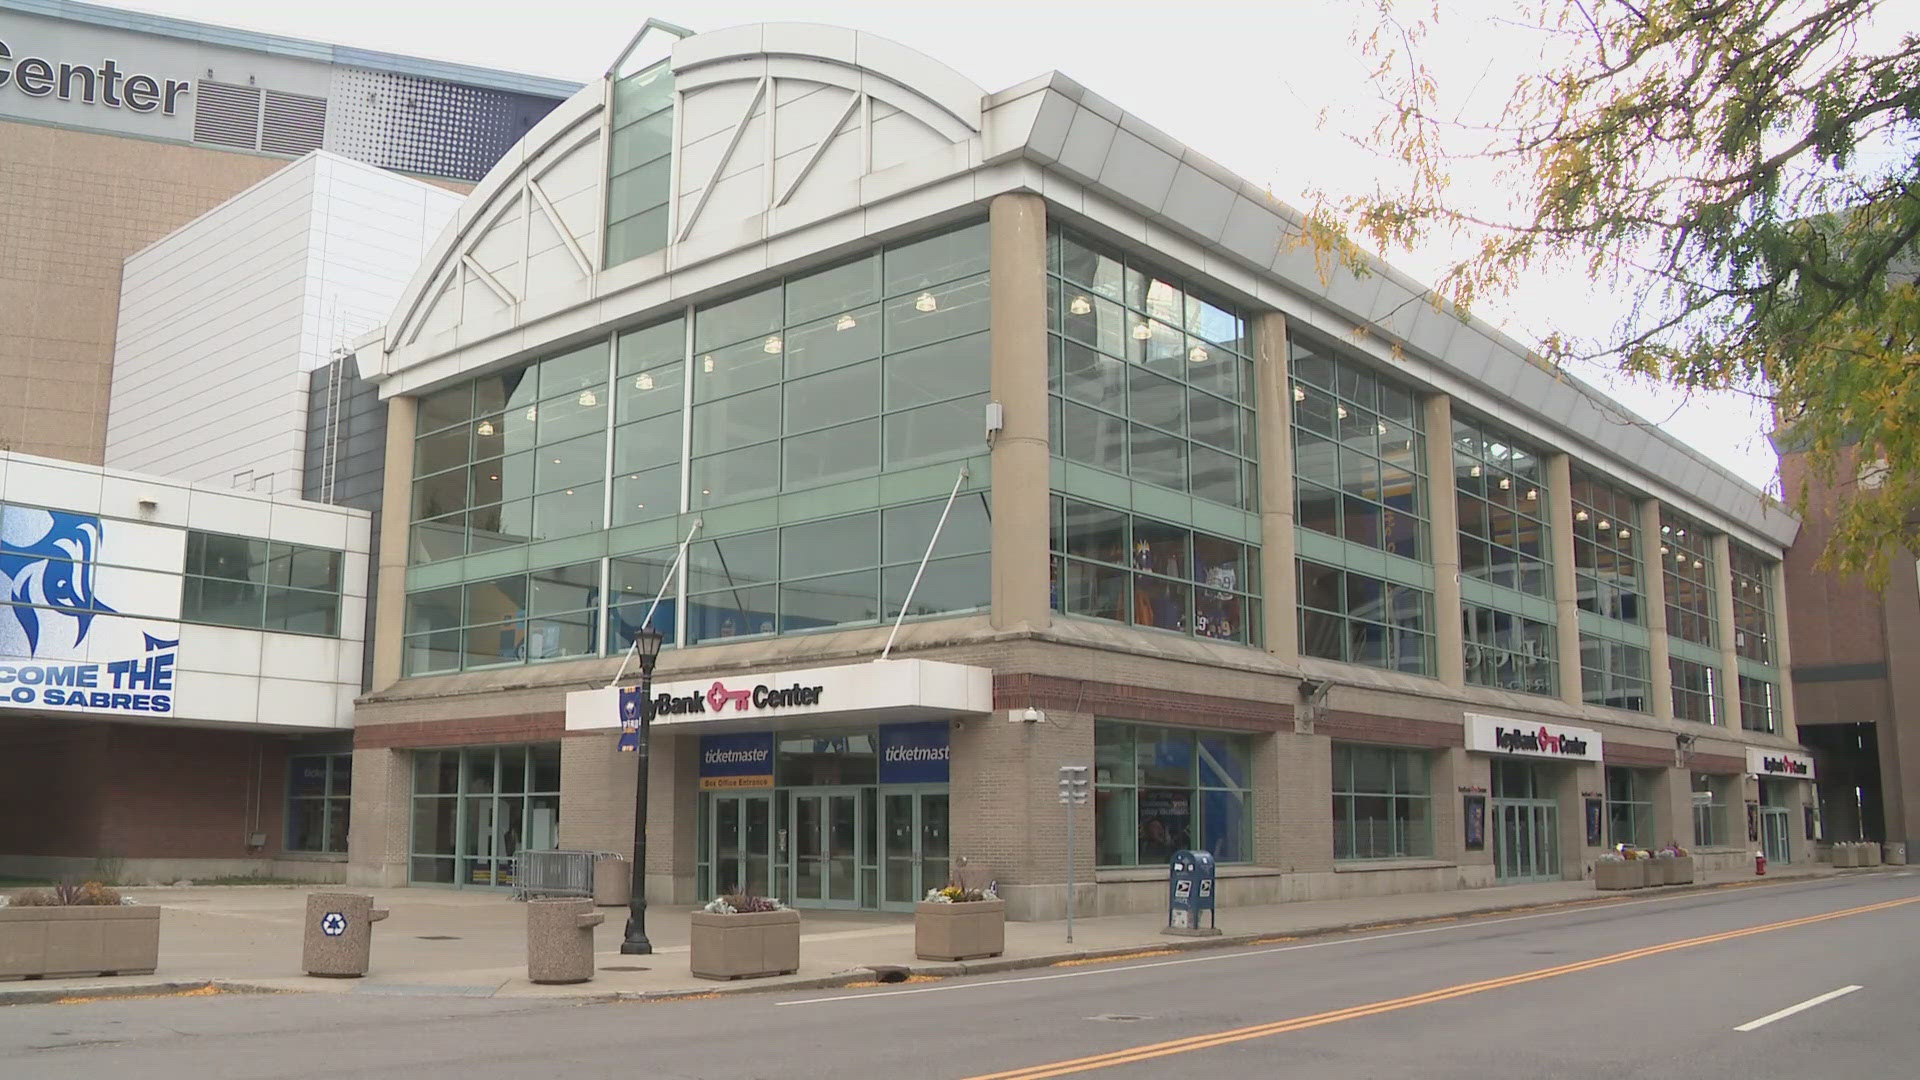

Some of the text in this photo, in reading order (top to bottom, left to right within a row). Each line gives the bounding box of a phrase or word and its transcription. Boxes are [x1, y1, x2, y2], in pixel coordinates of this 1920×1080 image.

[0, 39, 190, 115] enter
[107, 653, 175, 691] THE
[43, 688, 171, 712] SABRES
[649, 683, 823, 721] yBank Center
[705, 748, 769, 764] ticketmaster
[885, 745, 950, 761] ticketmast
